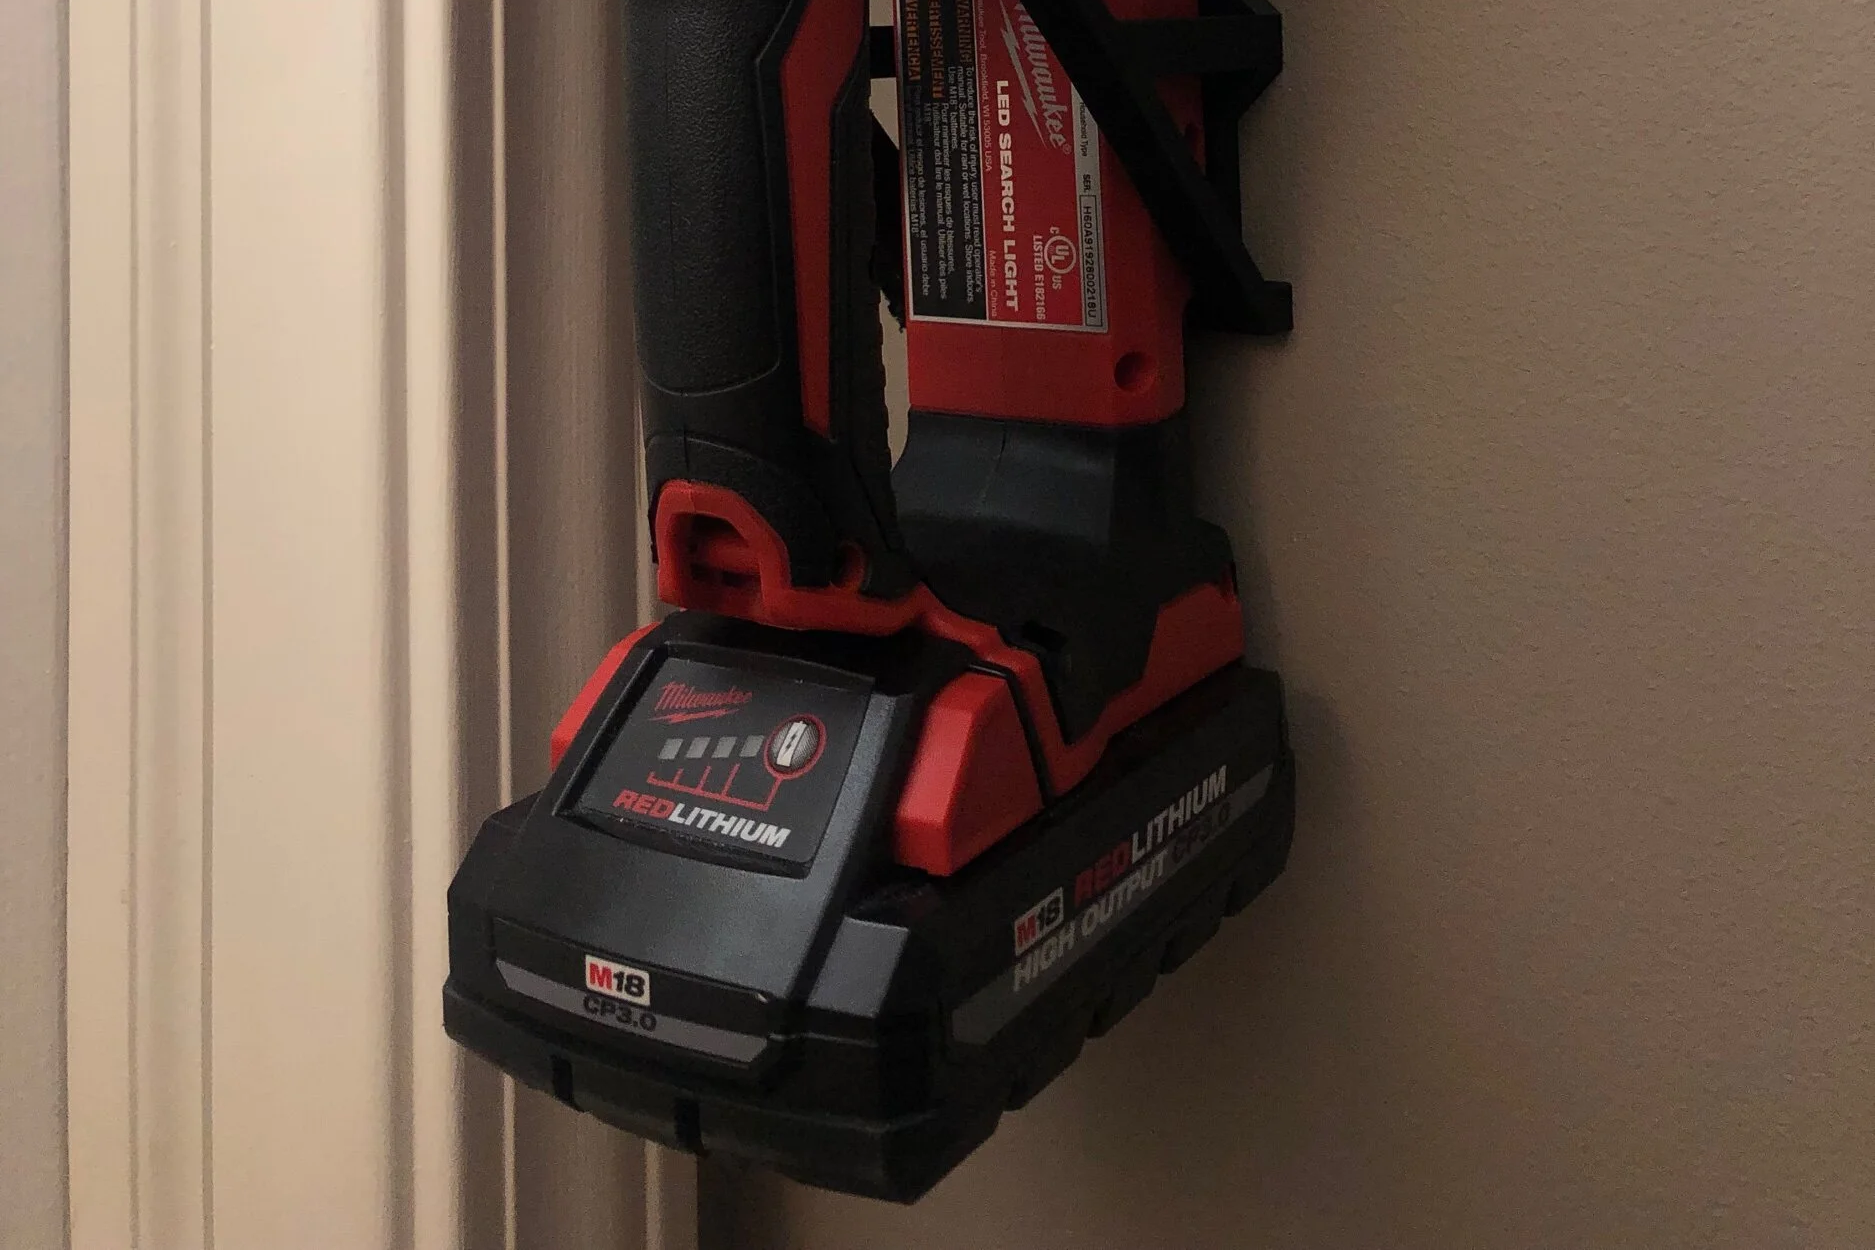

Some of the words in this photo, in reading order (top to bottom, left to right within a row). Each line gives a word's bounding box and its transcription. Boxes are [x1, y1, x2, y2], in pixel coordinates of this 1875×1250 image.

[948, 66, 956, 83] Use
[966, 66, 974, 76] To
[967, 78, 975, 108] reduce
[996, 80, 1010, 126] LED
[941, 102, 949, 123] Pour
[959, 102, 968, 138] Suitable
[968, 110, 976, 124] the
[983, 104, 990, 118] WI
[969, 126, 977, 142] risk
[983, 119, 991, 149] 53005
[943, 125, 951, 167] minimiser
[960, 140, 968, 152] for
[970, 143, 978, 153] of
[1080, 140, 1090, 157] Type
[934, 149, 942, 165] doit
[961, 153, 969, 170] rain
[984, 151, 993, 172] USA
[918, 177, 926, 188] de
[935, 167, 943, 181] lire
[944, 168, 952, 181] les
[962, 171, 969, 181] or
[998, 133, 1015, 231] SEARCH
[1083, 174, 1091, 192] SER.
[936, 182, 943, 191] le
[971, 182, 979, 200] user
[943, 183, 953, 214] risques
[946, 216, 954, 228] de
[973, 203, 981, 224] must
[920, 229, 928, 238] el
[973, 227, 982, 247] read
[920, 240, 929, 272] usuario
[965, 244, 974, 267] Store
[989, 250, 997, 276] Made
[1033, 235, 1044, 272] LISTED
[939, 260, 947, 277] des
[973, 249, 983, 293] operator's
[1003, 239, 1019, 311] LIGHT
[922, 274, 931, 296] debe
[939, 278, 948, 300] piles
[991, 278, 998, 287] in
[1052, 275, 1062, 290] US
[991, 290, 999, 317] China
[1034, 274, 1046, 320] E182166
[612, 789, 791, 848] REDLITHIUM
[1017, 897, 1061, 947] M18
[1073, 764, 1228, 908] REDLITHIUM
[1013, 922, 1076, 992] HIGH
[1081, 849, 1168, 938] OUTPUT
[589, 963, 645, 997] M18
[583, 995, 657, 1032] CP3.0
